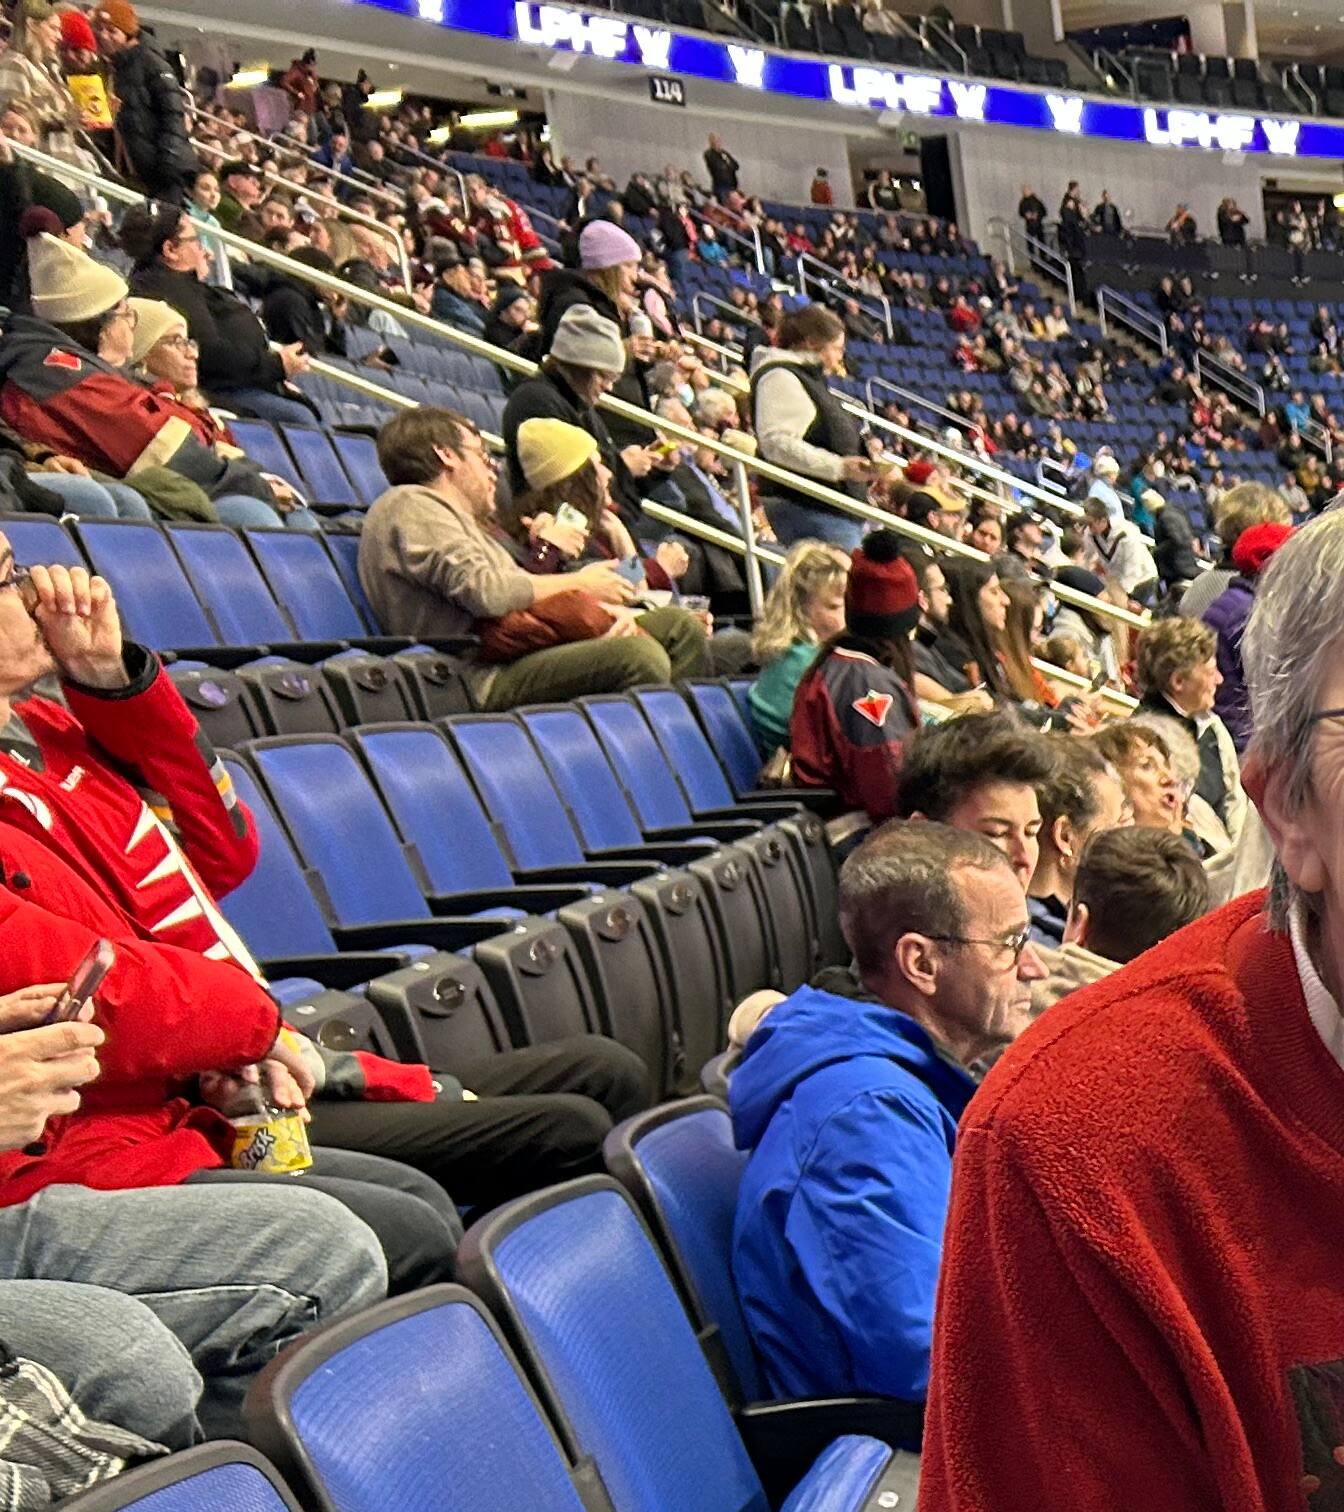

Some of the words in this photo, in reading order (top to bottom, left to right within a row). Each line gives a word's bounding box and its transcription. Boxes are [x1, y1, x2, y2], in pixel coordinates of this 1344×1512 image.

[517, 0, 627, 54] LPHF
[829, 61, 942, 114] LPHF
[1143, 106, 1256, 150] LPHF
